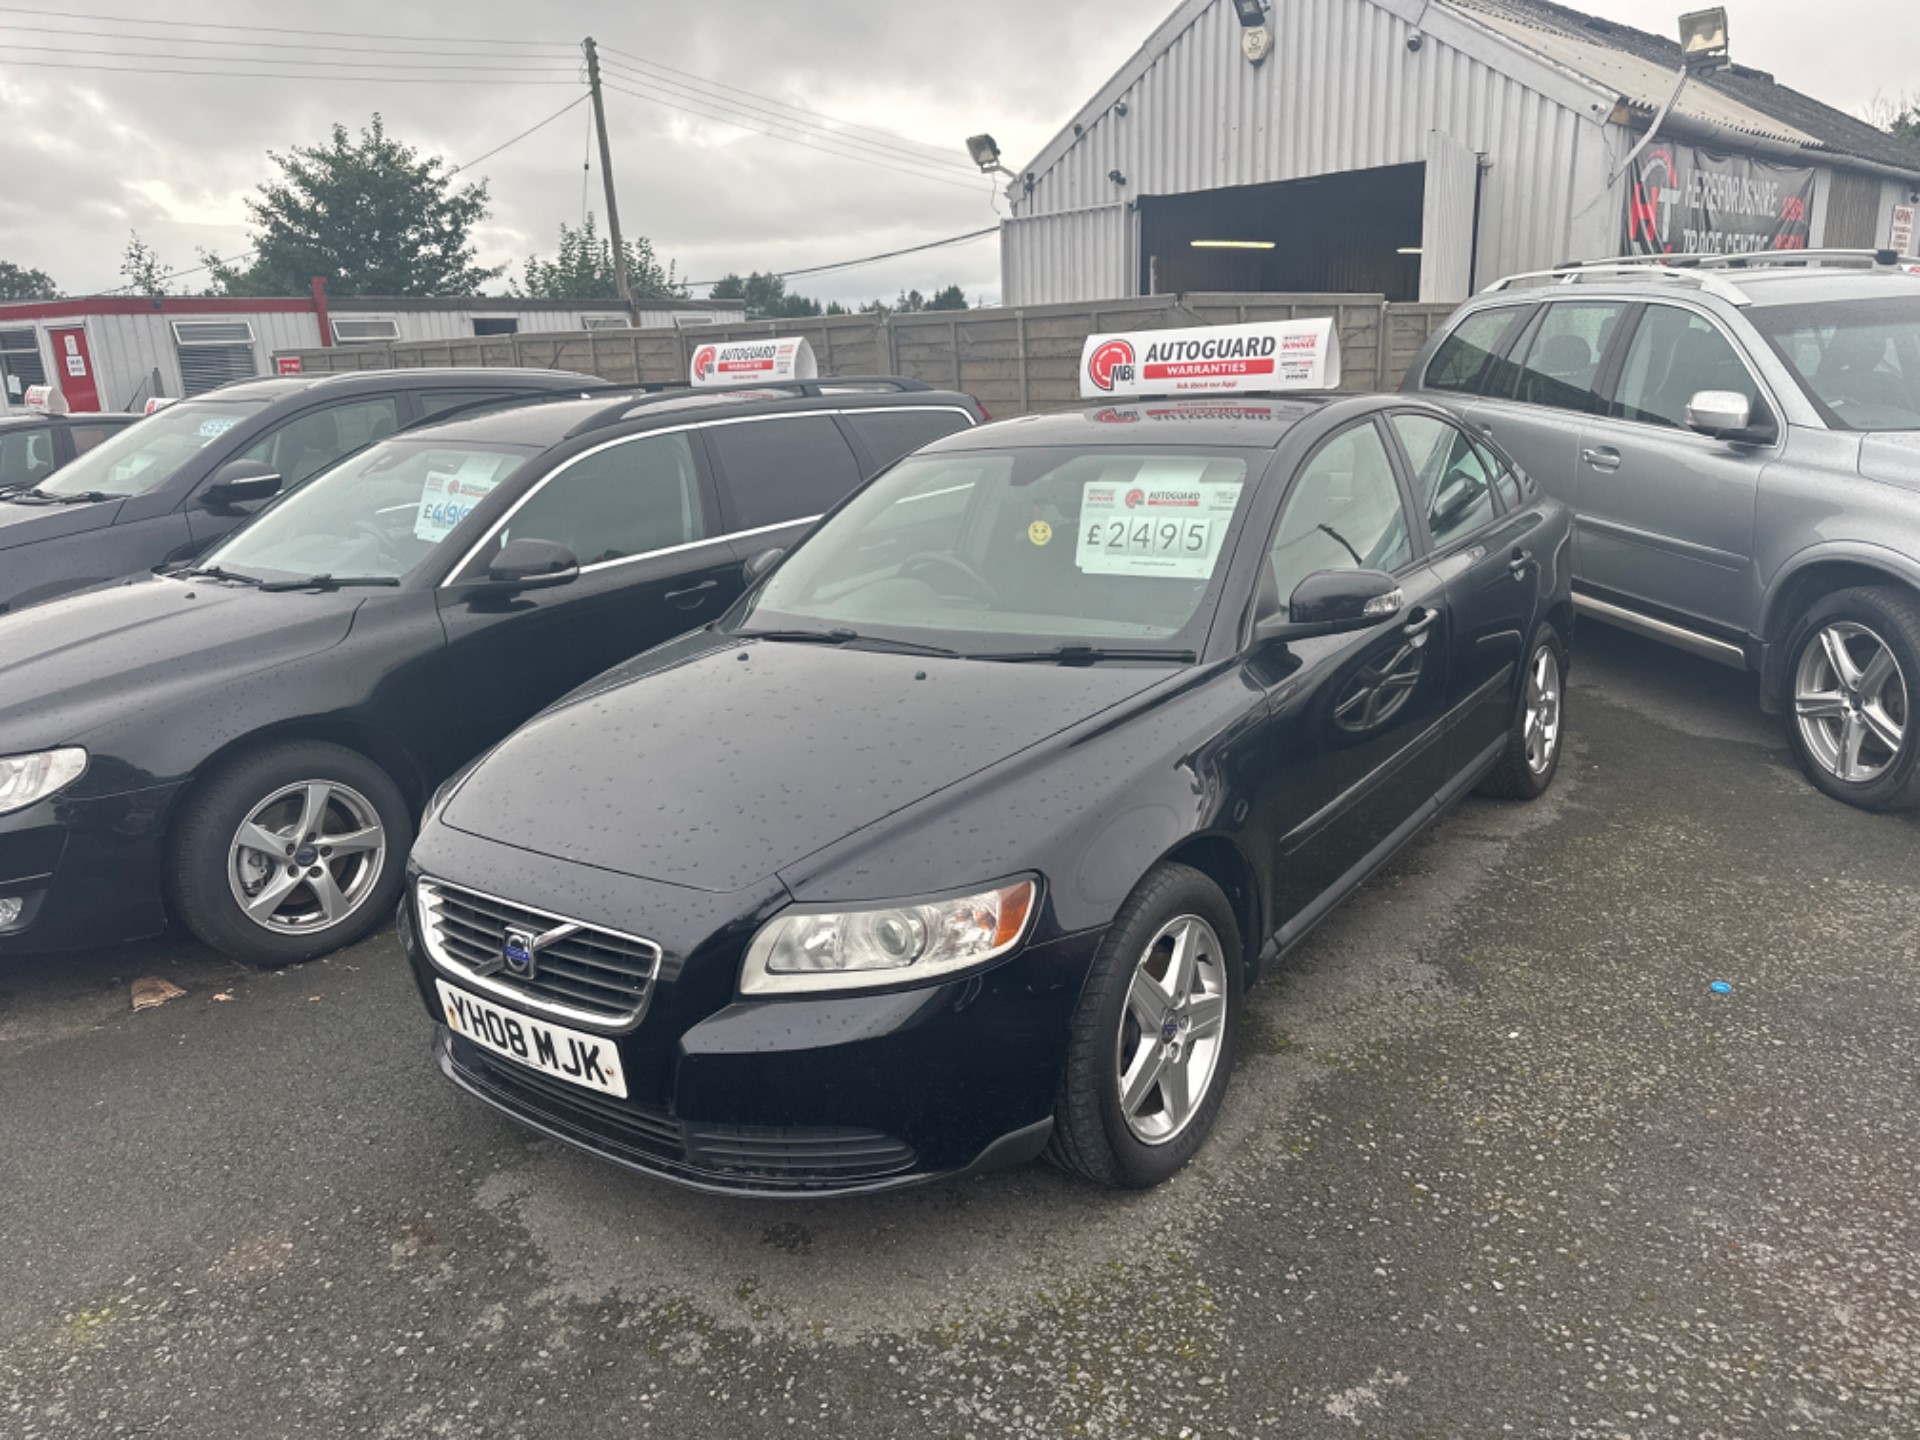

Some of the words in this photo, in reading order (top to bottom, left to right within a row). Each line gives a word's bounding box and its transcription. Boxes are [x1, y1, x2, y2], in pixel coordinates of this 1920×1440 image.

[720, 345, 777, 361] AUTOGUARD
[1145, 336, 1276, 363] AUTOGUARD
[1166, 363, 1247, 376] WARRANTIES
[1149, 491, 1200, 500] AUTOGUARD
[448, 991, 528, 1058] YH08
[531, 1026, 608, 1085] MJK
